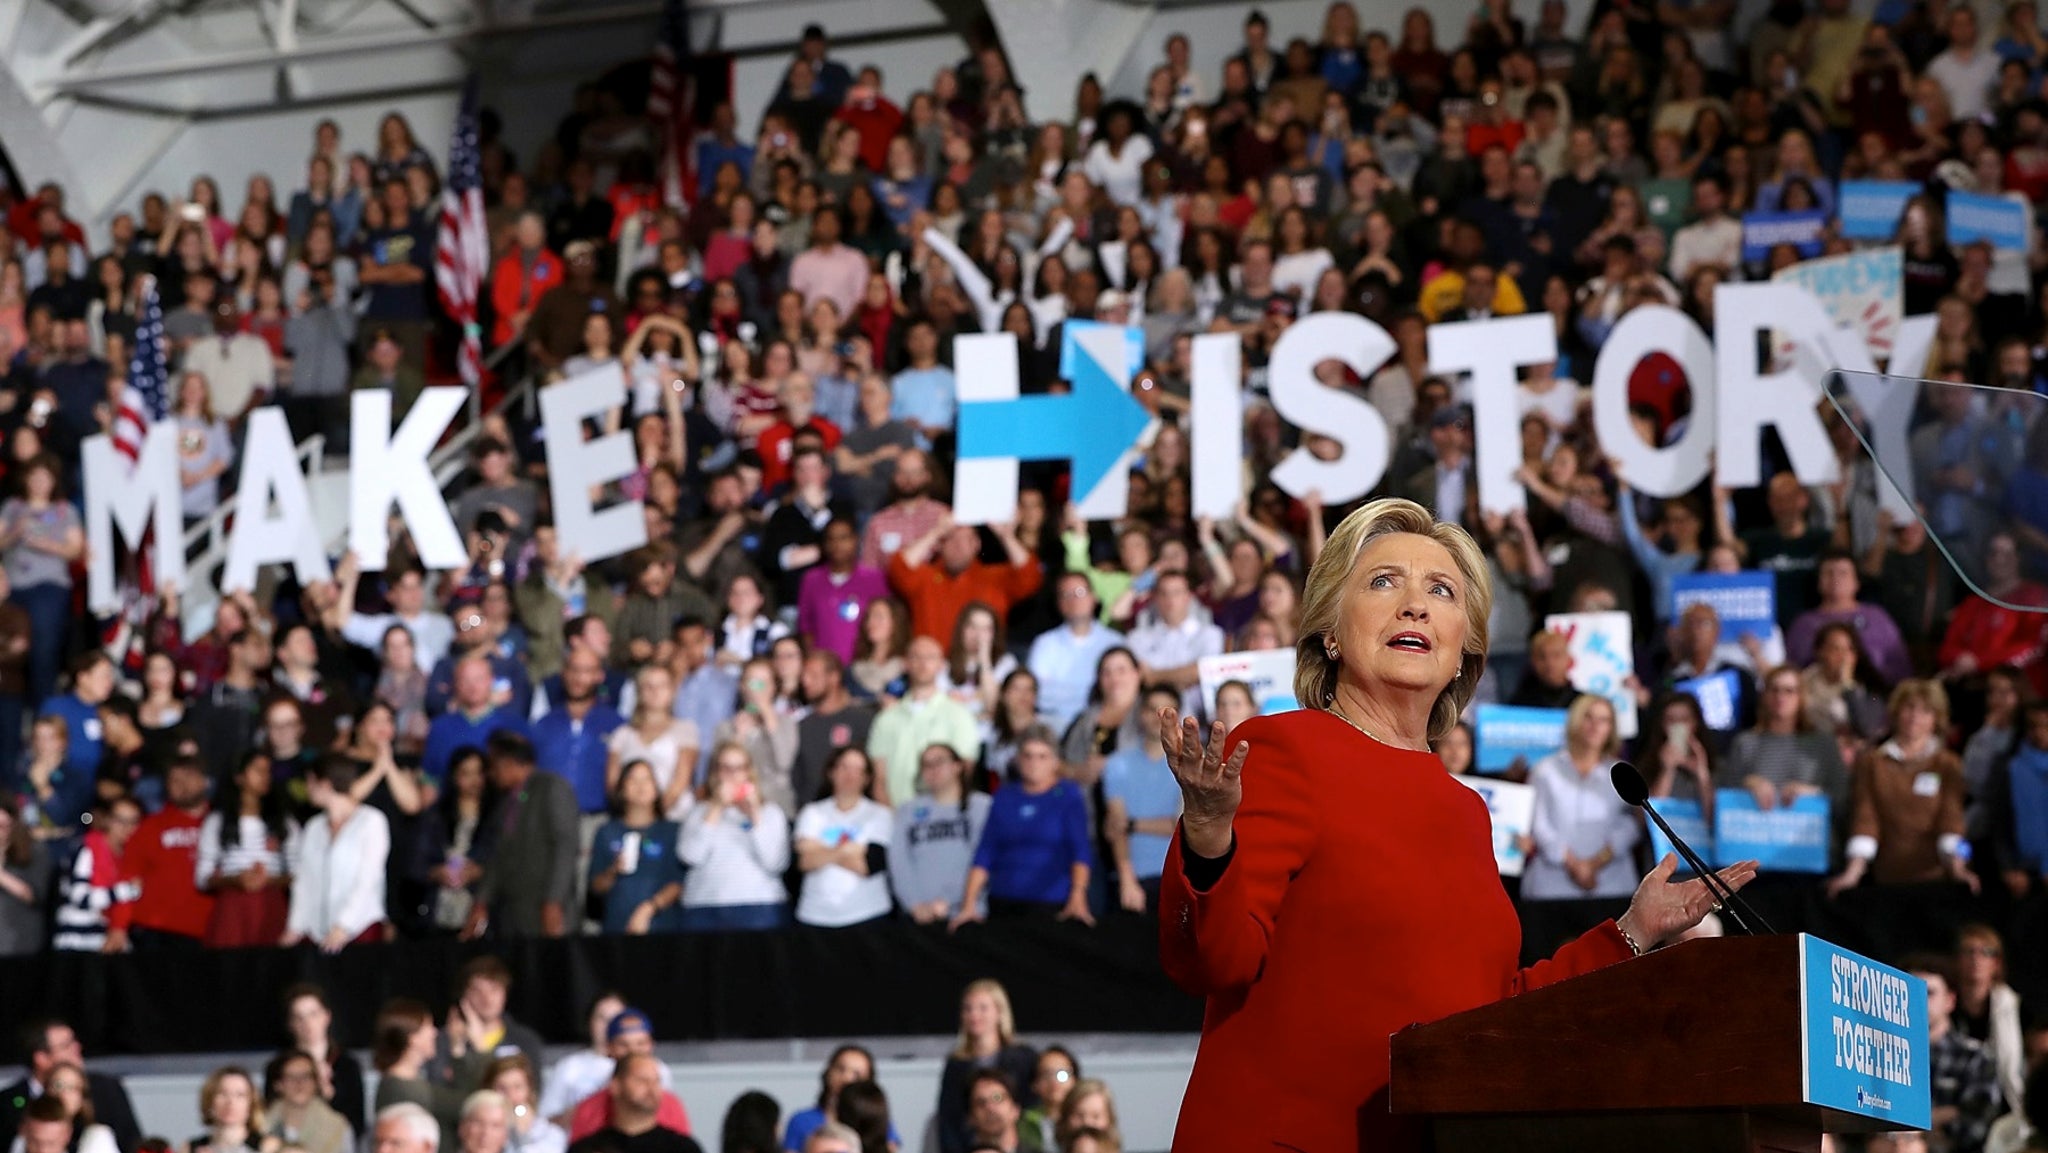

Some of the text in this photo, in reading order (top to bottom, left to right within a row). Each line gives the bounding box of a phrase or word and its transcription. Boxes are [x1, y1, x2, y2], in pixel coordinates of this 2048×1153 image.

[81, 282, 1939, 615] MAKE HISTORY
[1831, 953, 1910, 1028] STRONGER
[1833, 1016, 1911, 1086] TOGETHER
